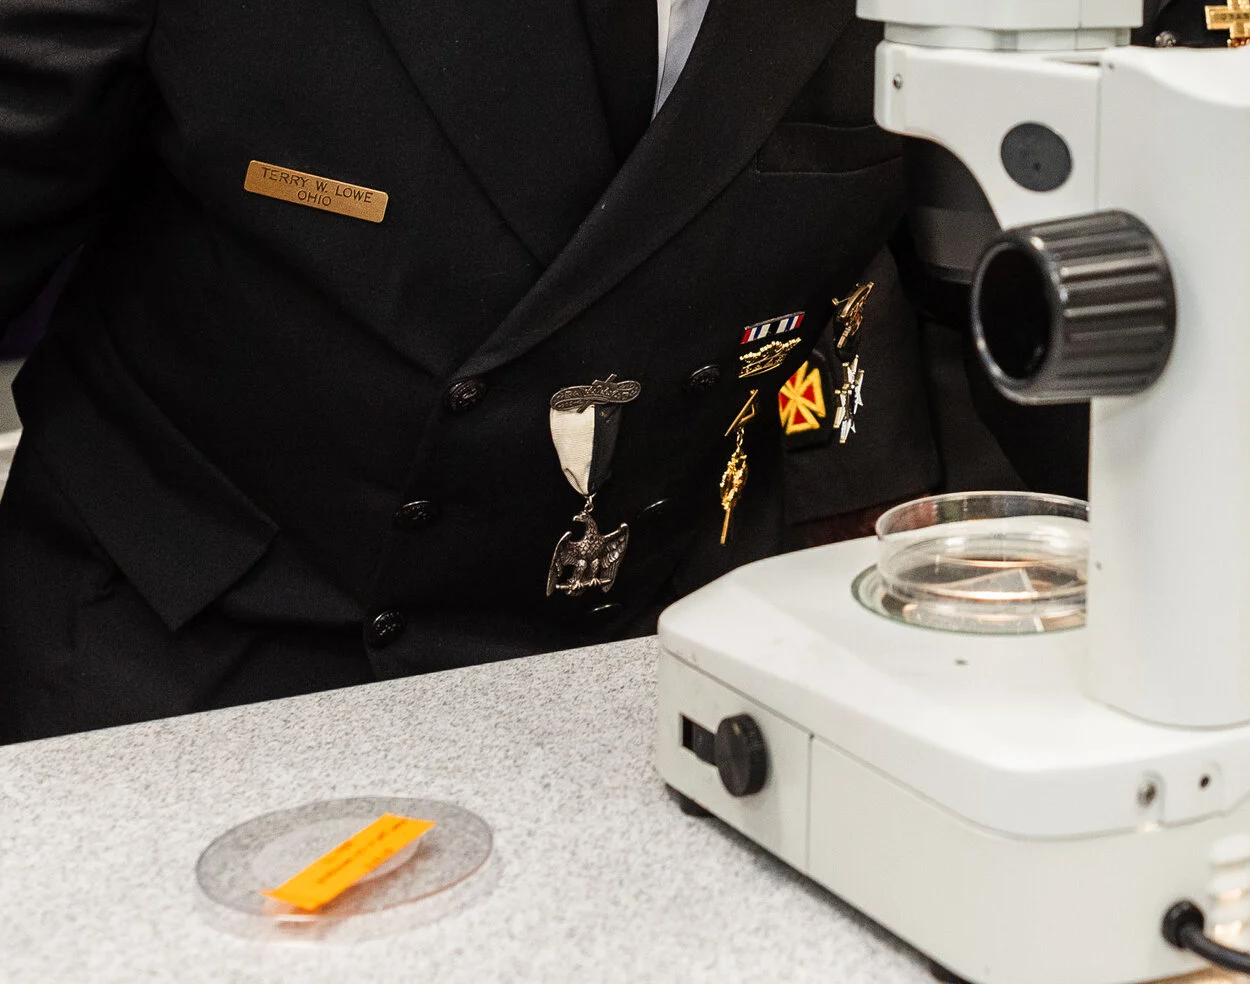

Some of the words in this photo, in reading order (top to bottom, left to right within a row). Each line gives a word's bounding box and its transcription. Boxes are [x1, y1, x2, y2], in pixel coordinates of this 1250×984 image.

[262, 167, 310, 187] TERRY
[316, 180, 328, 194] W.
[335, 185, 374, 203] LOWE
[297, 190, 332, 207] OHIO
